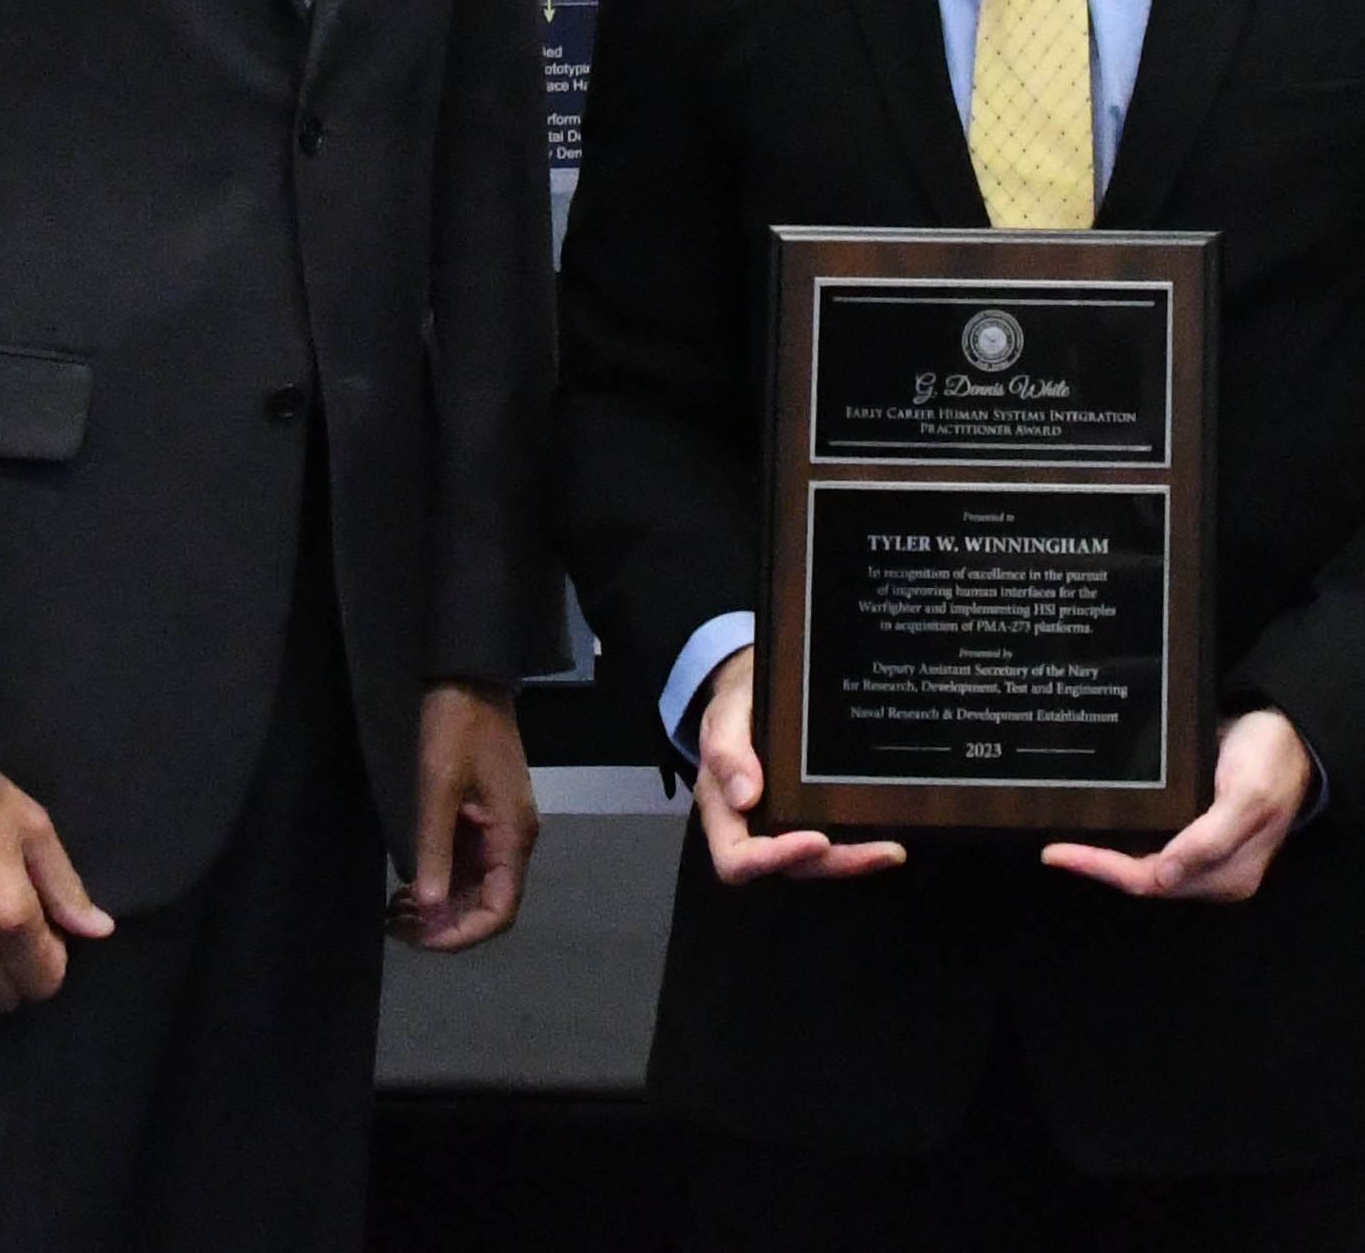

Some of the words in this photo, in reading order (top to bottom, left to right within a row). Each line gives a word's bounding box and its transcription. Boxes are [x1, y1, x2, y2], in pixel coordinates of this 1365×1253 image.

[944, 374, 1005, 397] Dennis
[1009, 374, 1070, 400] White
[846, 406, 883, 419] EARLY
[886, 407, 934, 420] CAREER
[939, 408, 988, 421] HUMAN
[993, 409, 1045, 421] SYSTEMS
[1050, 409, 1137, 423] INTEGRATION
[920, 422, 1012, 436] PRACTITIONER
[1015, 425, 1062, 437] AWARD
[867, 534, 931, 552] TYLER
[936, 536, 959, 552] W.
[964, 536, 1109, 554] WINNINGHAM
[884, 568, 950, 582] recognition
[953, 566, 966, 579] of
[967, 567, 1026, 581] excellence
[1029, 569, 1041, 581] in
[1043, 569, 1063, 581] the
[1066, 569, 1107, 584] pursuit
[892, 585, 953, 600] improving
[955, 583, 997, 597] human
[1000, 585, 1056, 598] interfaces
[1058, 585, 1076, 598] for
[1079, 586, 1097, 599] the
[859, 600, 922, 616] Warfighter
[924, 601, 947, 614] and
[949, 601, 1031, 618] implementing
[1034, 603, 1056, 616] HSI
[1059, 603, 1116, 619] principles
[880, 620, 892, 630] in
[894, 620, 958, 634] acquisition
[961, 620, 974, 631] of
[873, 661, 916, 678] Deputy
[919, 662, 971, 676] Assistant
[974, 663, 1028, 679] Secretary
[1031, 663, 1045, 676] of
[1046, 663, 1065, 677] the
[1068, 663, 1099, 680] Navy
[1004, 680, 1028, 694] Test
[1031, 681, 1053, 694] and
[1056, 681, 1128, 699] Engineering
[851, 706, 884, 718] Naval
[888, 706, 940, 720] Research
[942, 709, 953, 720] &
[956, 707, 1033, 724] Development
[1036, 708, 1119, 723] Establishment
[965, 742, 1002, 758] 2023
